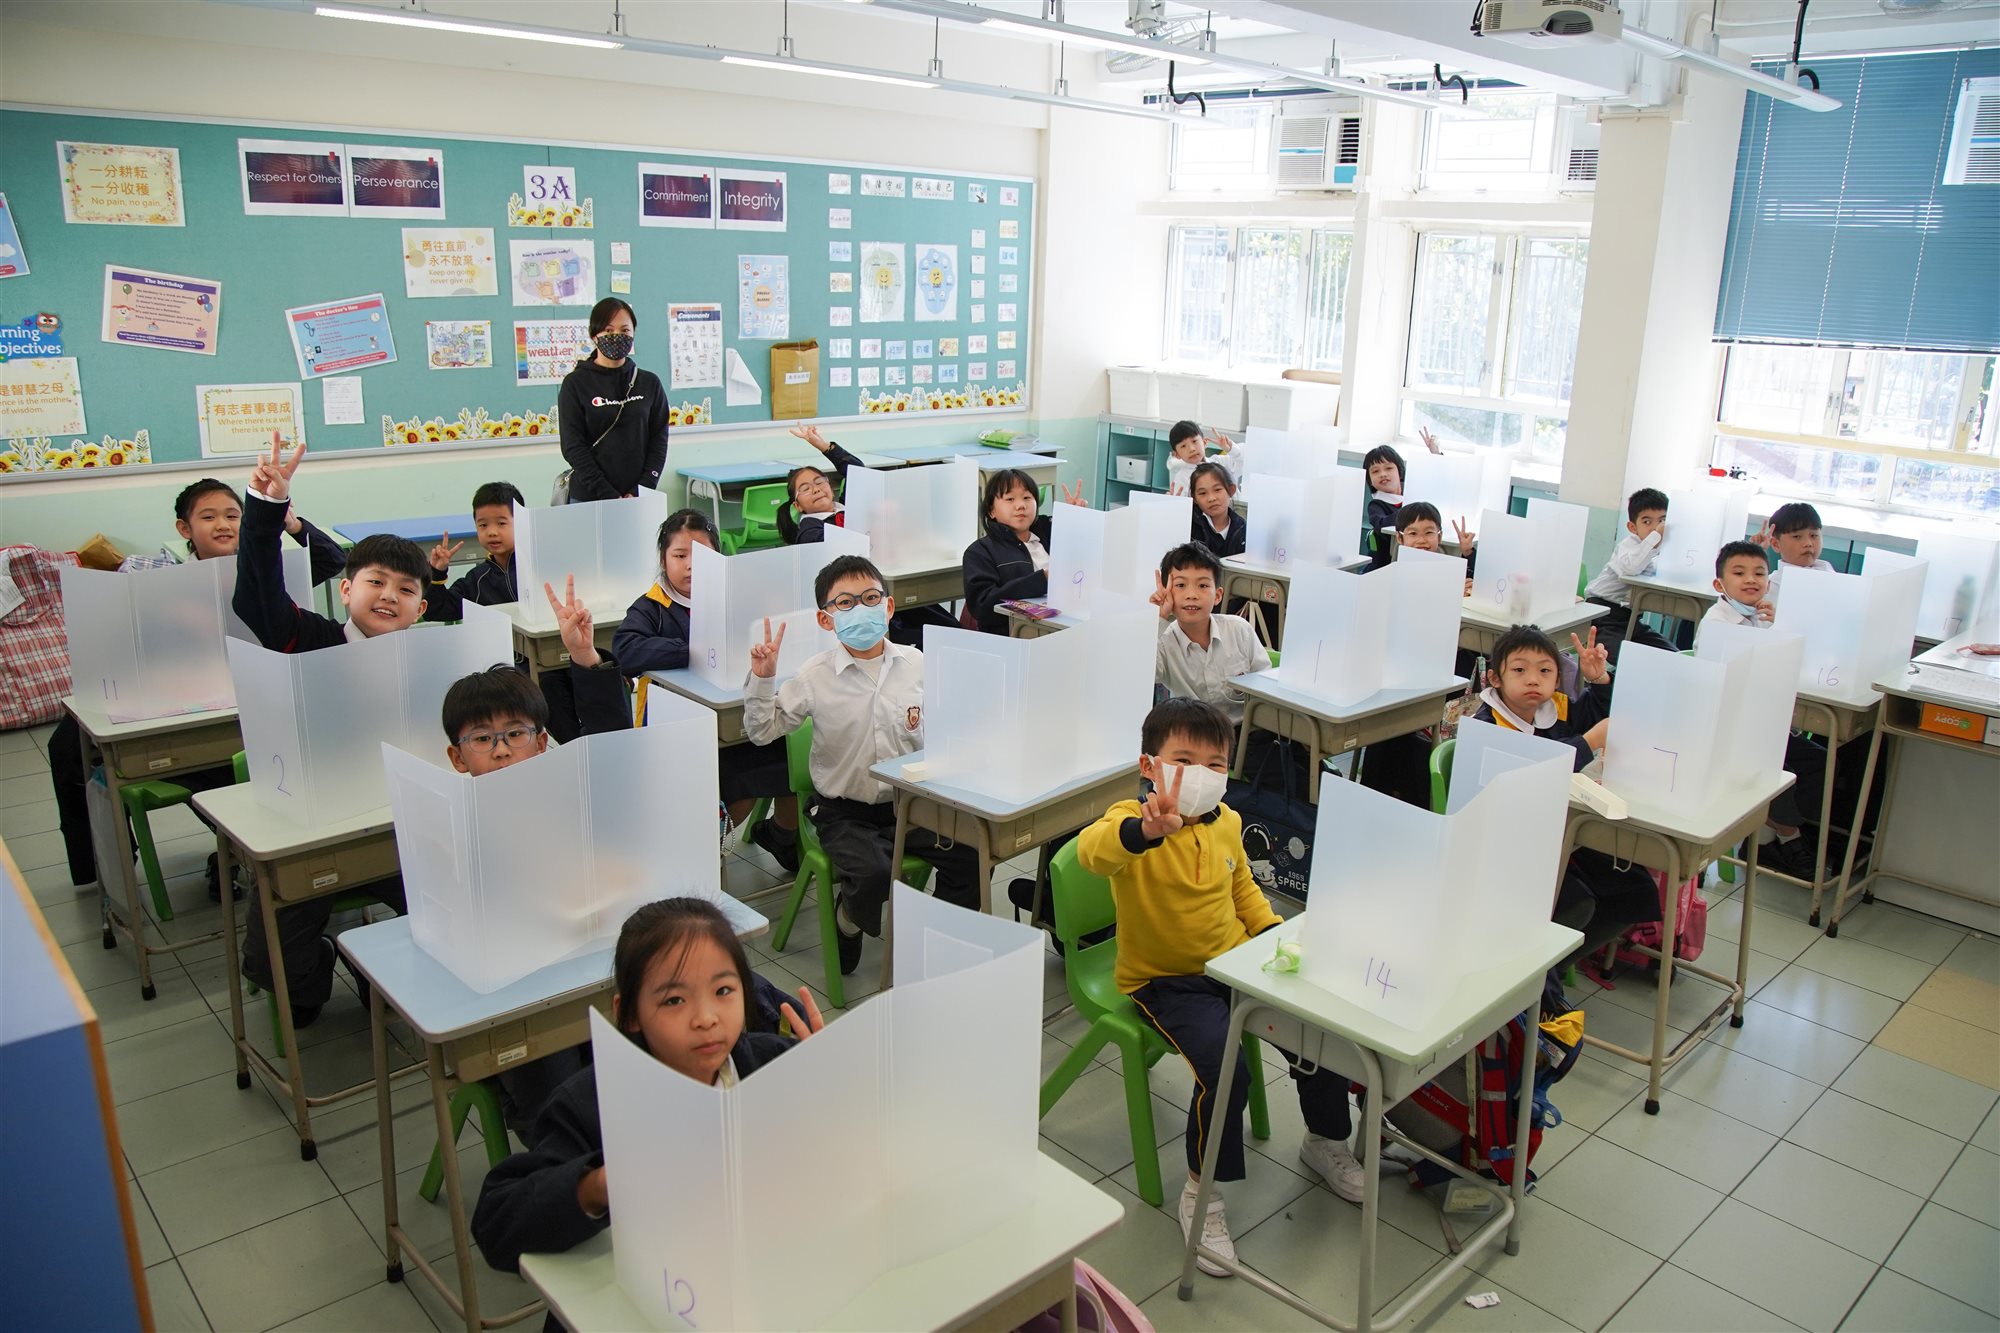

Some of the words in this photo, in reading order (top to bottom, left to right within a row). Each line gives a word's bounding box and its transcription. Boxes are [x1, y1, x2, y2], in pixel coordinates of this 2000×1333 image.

[88, 164, 148, 179] 一分耕耘
[248, 172, 290, 184] Respect
[292, 173, 306, 183] for
[309, 173, 342, 184] Others
[90, 181, 150, 196] 一分收穫
[353, 174, 439, 190] Perseverance
[91, 197, 105, 205] No
[644, 189, 709, 203] Commitment
[724, 191, 781, 211] Integrity
[422, 240, 467, 252] 勇往直前
[429, 255, 474, 267] 永不放棄
[144, 277, 157, 285] The
[157, 279, 185, 289] birthday
[528, 345, 573, 358] weather
[26, 397, 39, 405] the
[213, 401, 291, 416] 有志者事竟成
[1273, 546, 1286, 564] 18
[1685, 549, 1698, 568] 5
[1072, 569, 1085, 600] 9
[1495, 577, 1506, 605] 8
[707, 647, 717, 669] 13
[1817, 665, 1840, 688] 16
[102, 678, 118, 700] 11
[1934, 715, 1960, 726] COPY
[272, 754, 292, 797] 2
[1653, 747, 1679, 792] 7
[1277, 875, 1308, 892] SPACE
[1365, 956, 1398, 1000] 14
[663, 1267, 697, 1328] 12
